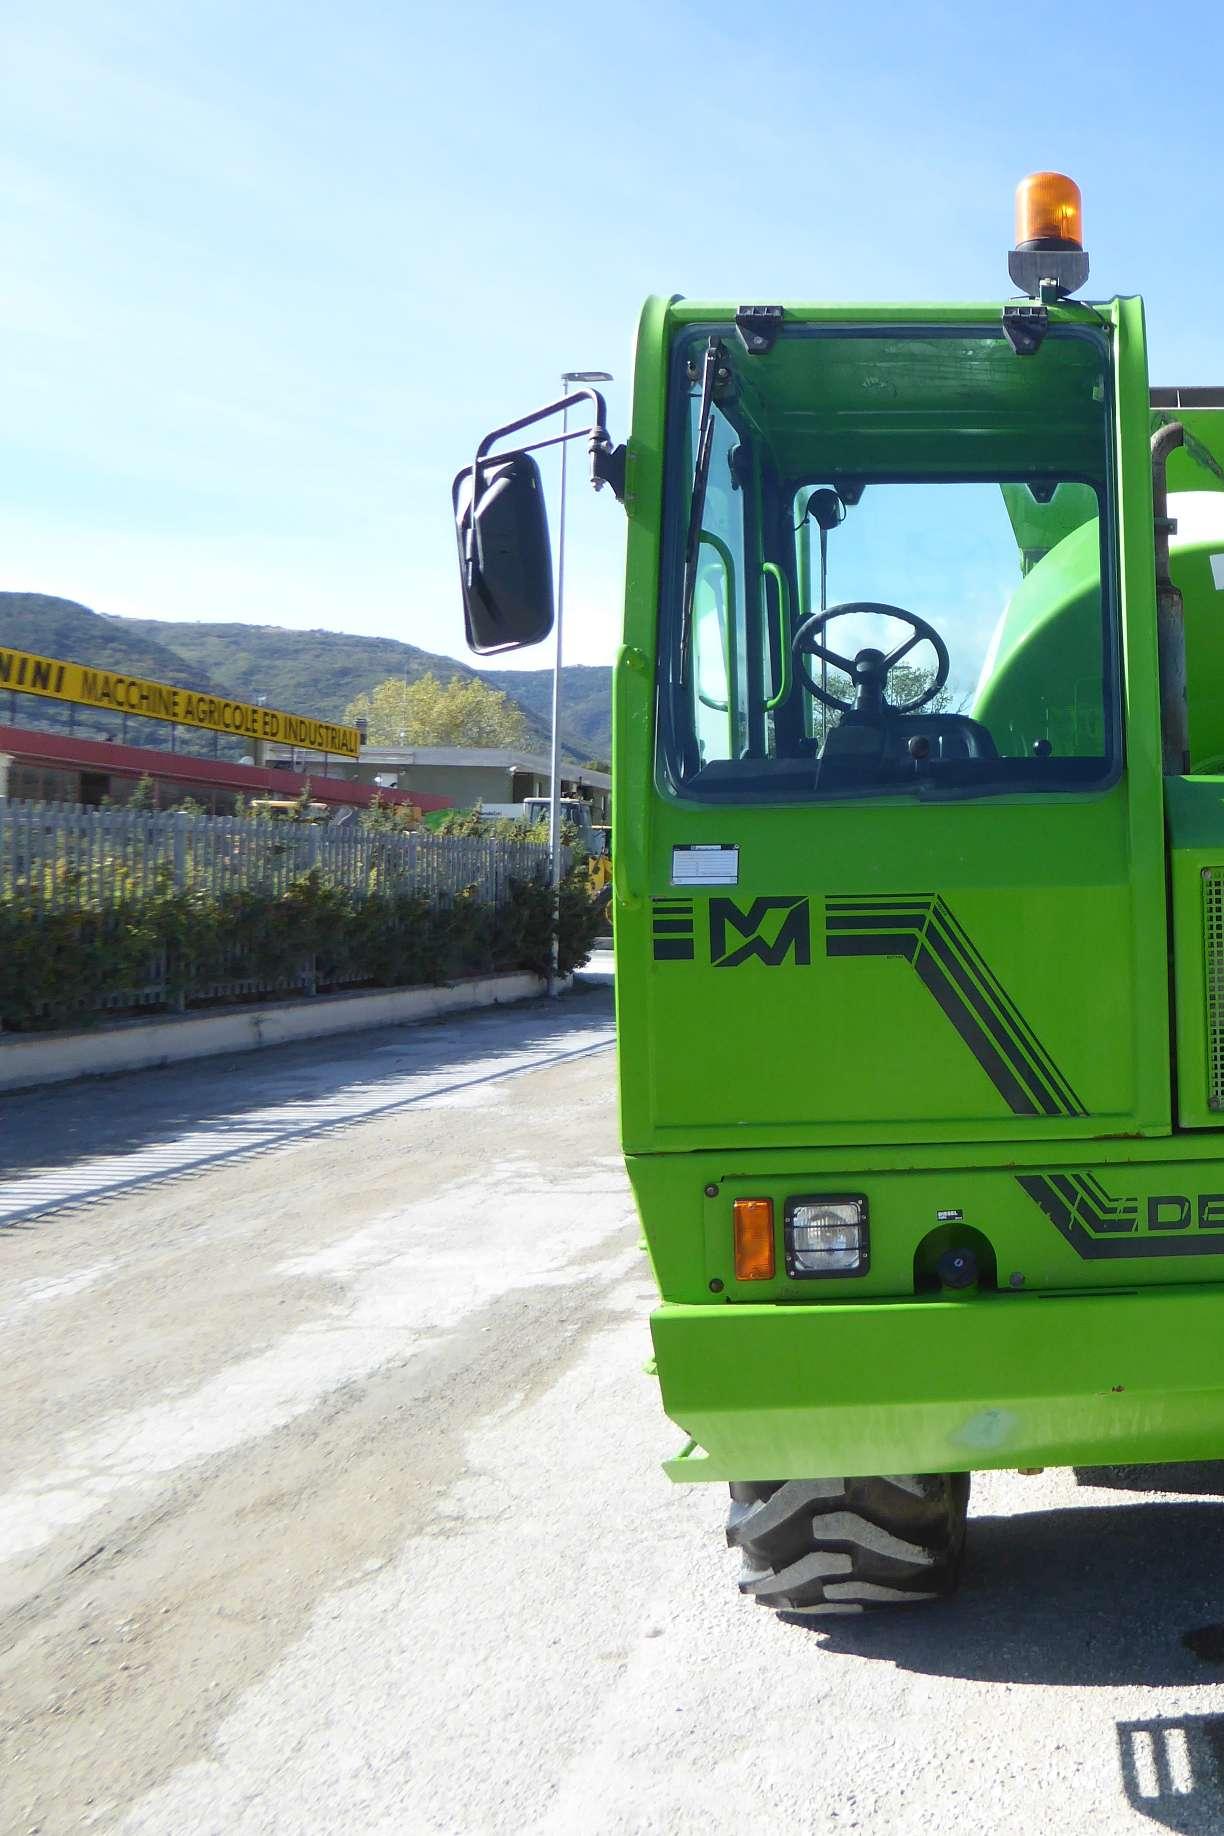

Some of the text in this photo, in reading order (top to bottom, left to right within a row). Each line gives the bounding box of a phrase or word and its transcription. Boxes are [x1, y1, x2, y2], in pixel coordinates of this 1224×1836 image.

[81, 670, 179, 717] MACCHINE
[184, 696, 258, 734] AGRICOLE
[263, 711, 280, 738] ED
[284, 715, 358, 753] INDUSTRIALI
